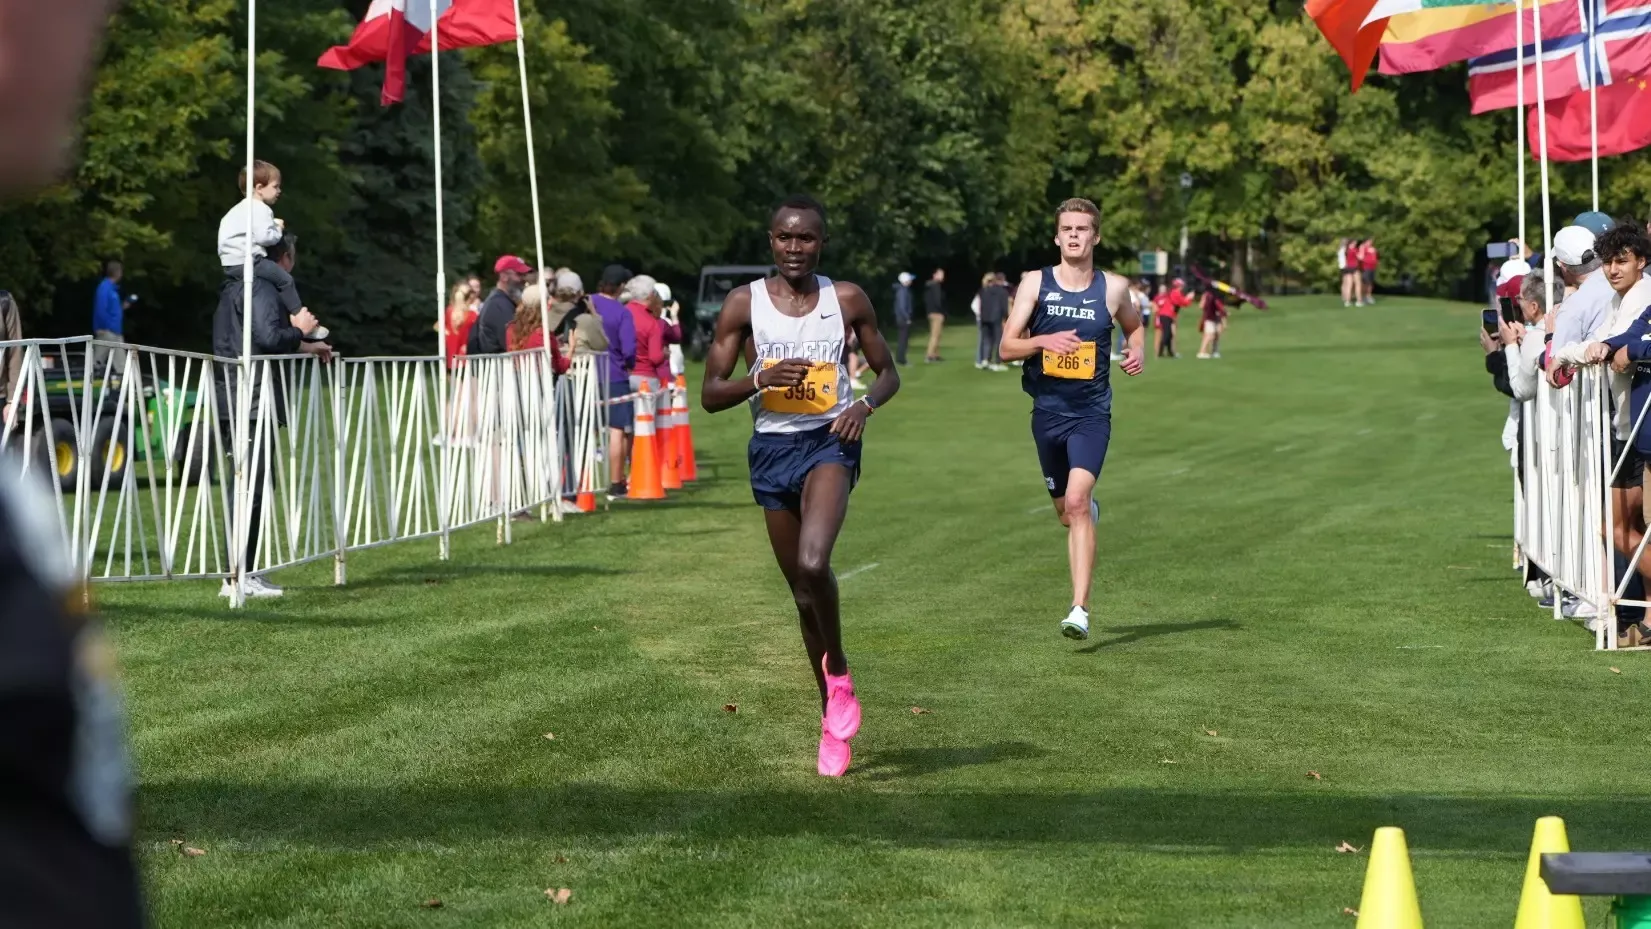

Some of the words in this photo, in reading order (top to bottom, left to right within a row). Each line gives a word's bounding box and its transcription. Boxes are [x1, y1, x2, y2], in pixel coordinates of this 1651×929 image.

[1047, 304, 1095, 320] BUTLER
[1057, 355, 1079, 369] 266
[784, 381, 815, 400] 395
